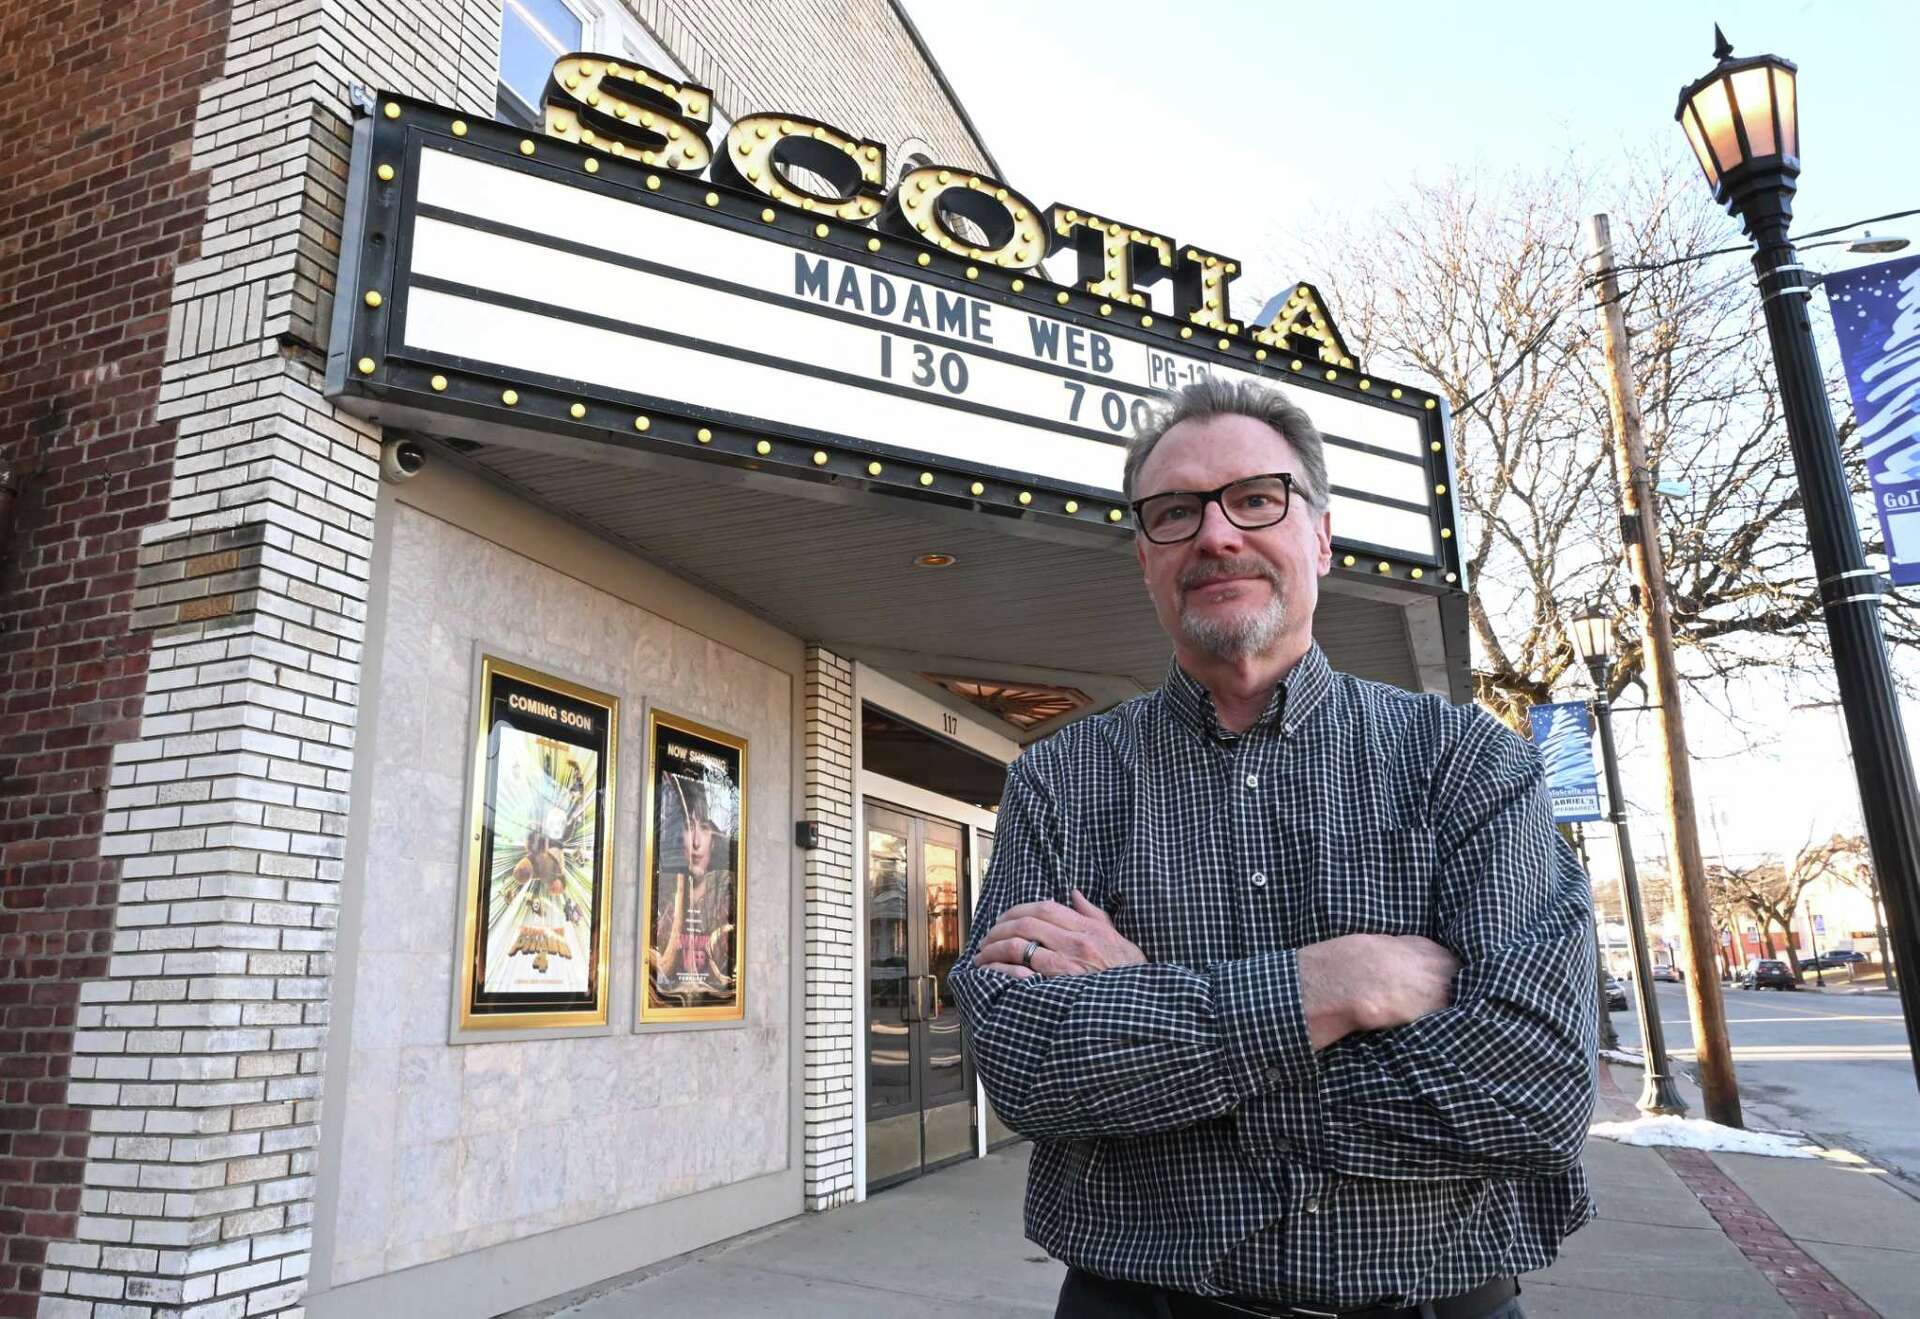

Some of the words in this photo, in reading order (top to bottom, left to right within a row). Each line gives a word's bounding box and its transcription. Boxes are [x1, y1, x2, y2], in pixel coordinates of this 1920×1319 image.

[542, 51, 1359, 370] SCOTIA
[795, 252, 994, 344] MADAME
[1028, 316, 1114, 373] WEB
[509, 693, 558, 720] COMING
[560, 709, 592, 731] SOON
[943, 712, 957, 736] 117
[667, 743, 688, 759] NOW
